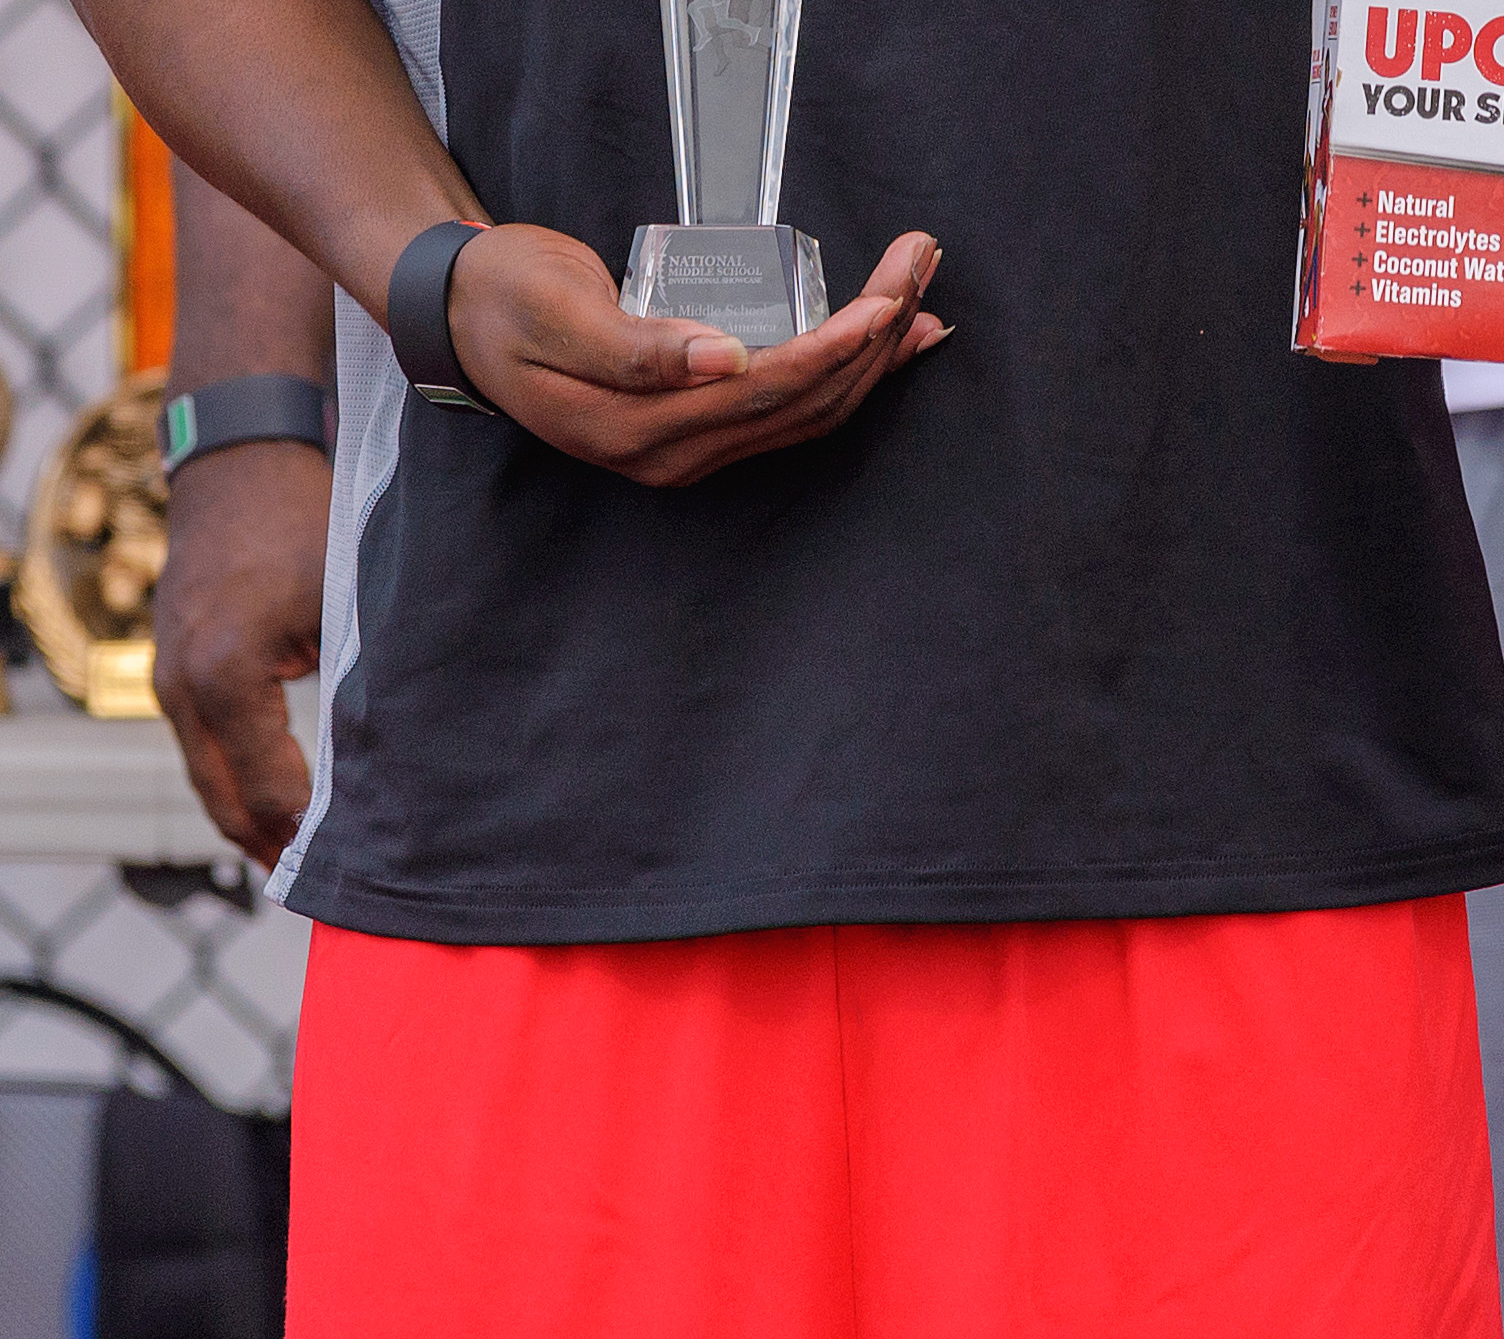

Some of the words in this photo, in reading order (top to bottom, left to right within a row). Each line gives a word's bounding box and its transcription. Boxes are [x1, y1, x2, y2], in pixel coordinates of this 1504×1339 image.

[1362, 83, 1466, 122] YOUR
[1377, 190, 1455, 219] Natural
[1375, 220, 1501, 254] Electrolytes
[668, 255, 746, 267] NATIONAL
[668, 267, 714, 277] MIDDLE
[716, 266, 762, 276] SCHOOL
[1373, 250, 1458, 279] Coconut
[1371, 278, 1462, 308] Vitamins
[649, 304, 674, 318] Best
[678, 303, 722, 317] Middle
[725, 303, 769, 317] School
[727, 323, 777, 334] America
